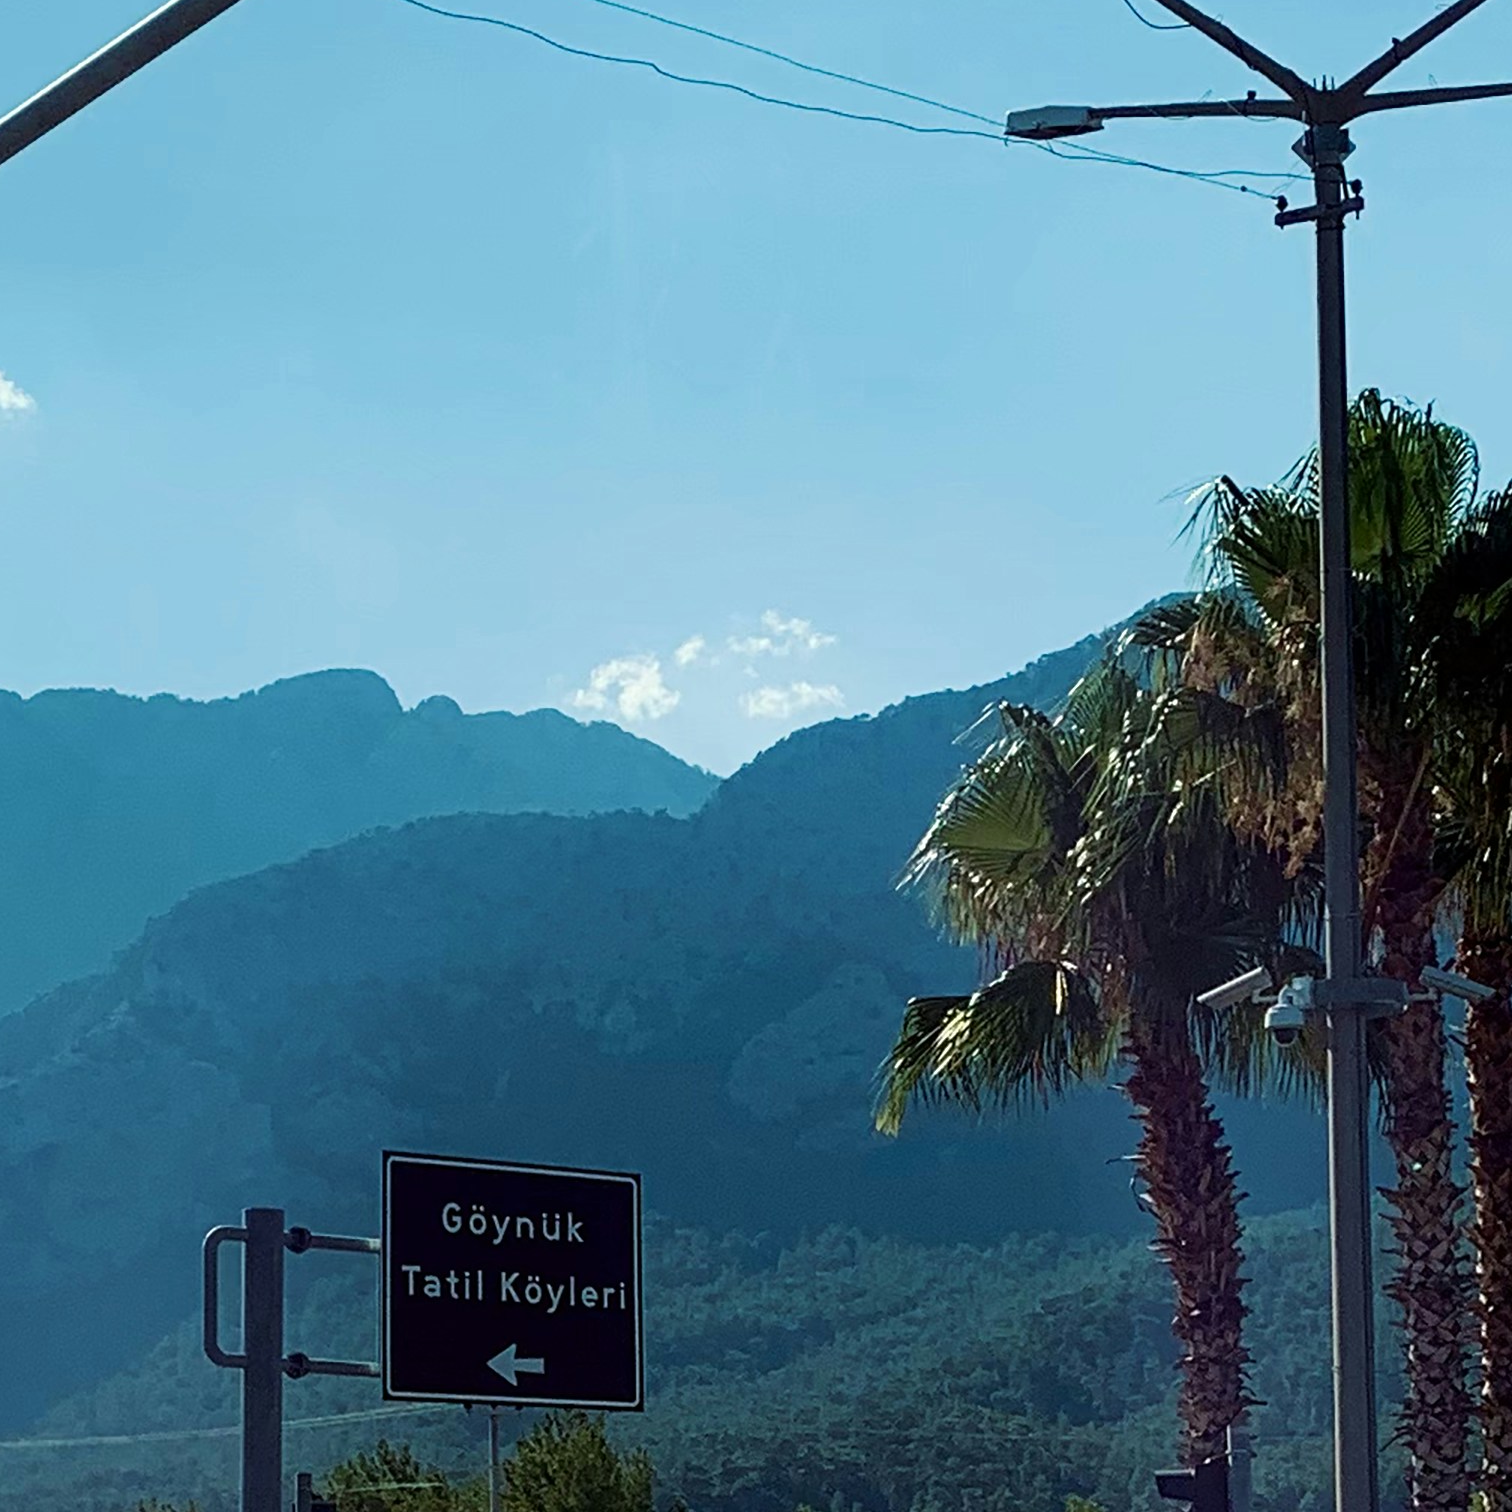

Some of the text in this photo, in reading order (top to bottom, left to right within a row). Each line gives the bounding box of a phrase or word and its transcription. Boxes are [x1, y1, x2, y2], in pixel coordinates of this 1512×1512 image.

[442, 1202, 584, 1245] Göynük
[401, 1264, 626, 1314] Tatil Köyleri
